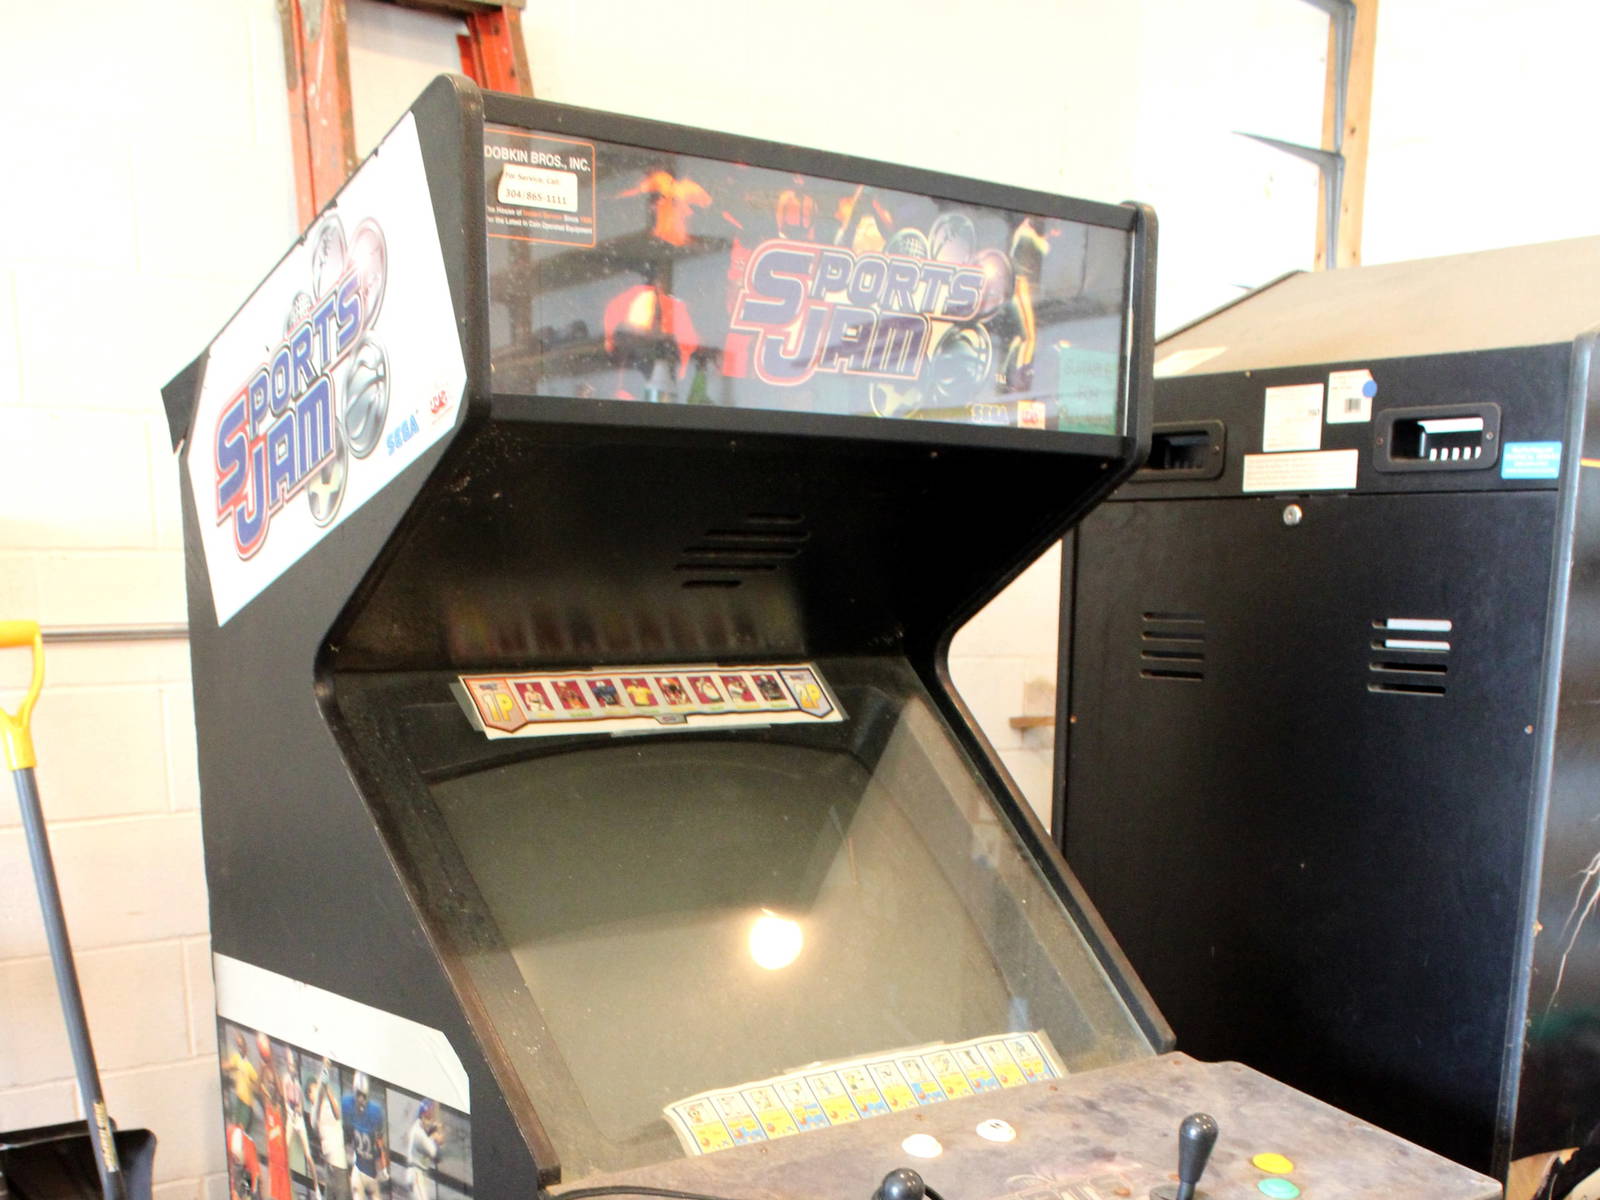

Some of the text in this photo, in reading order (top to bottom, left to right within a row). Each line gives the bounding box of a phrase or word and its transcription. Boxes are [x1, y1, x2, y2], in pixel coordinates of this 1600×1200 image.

[485, 145, 591, 172] DOBKIN BROS., INC.
[733, 240, 985, 330] SPORTS
[753, 300, 932, 387] JAM
[215, 270, 364, 523] SPORTS
[233, 372, 336, 560] JAM
[386, 414, 420, 457] SEGA
[481, 692, 513, 722] 1P
[794, 682, 822, 710] 2P
